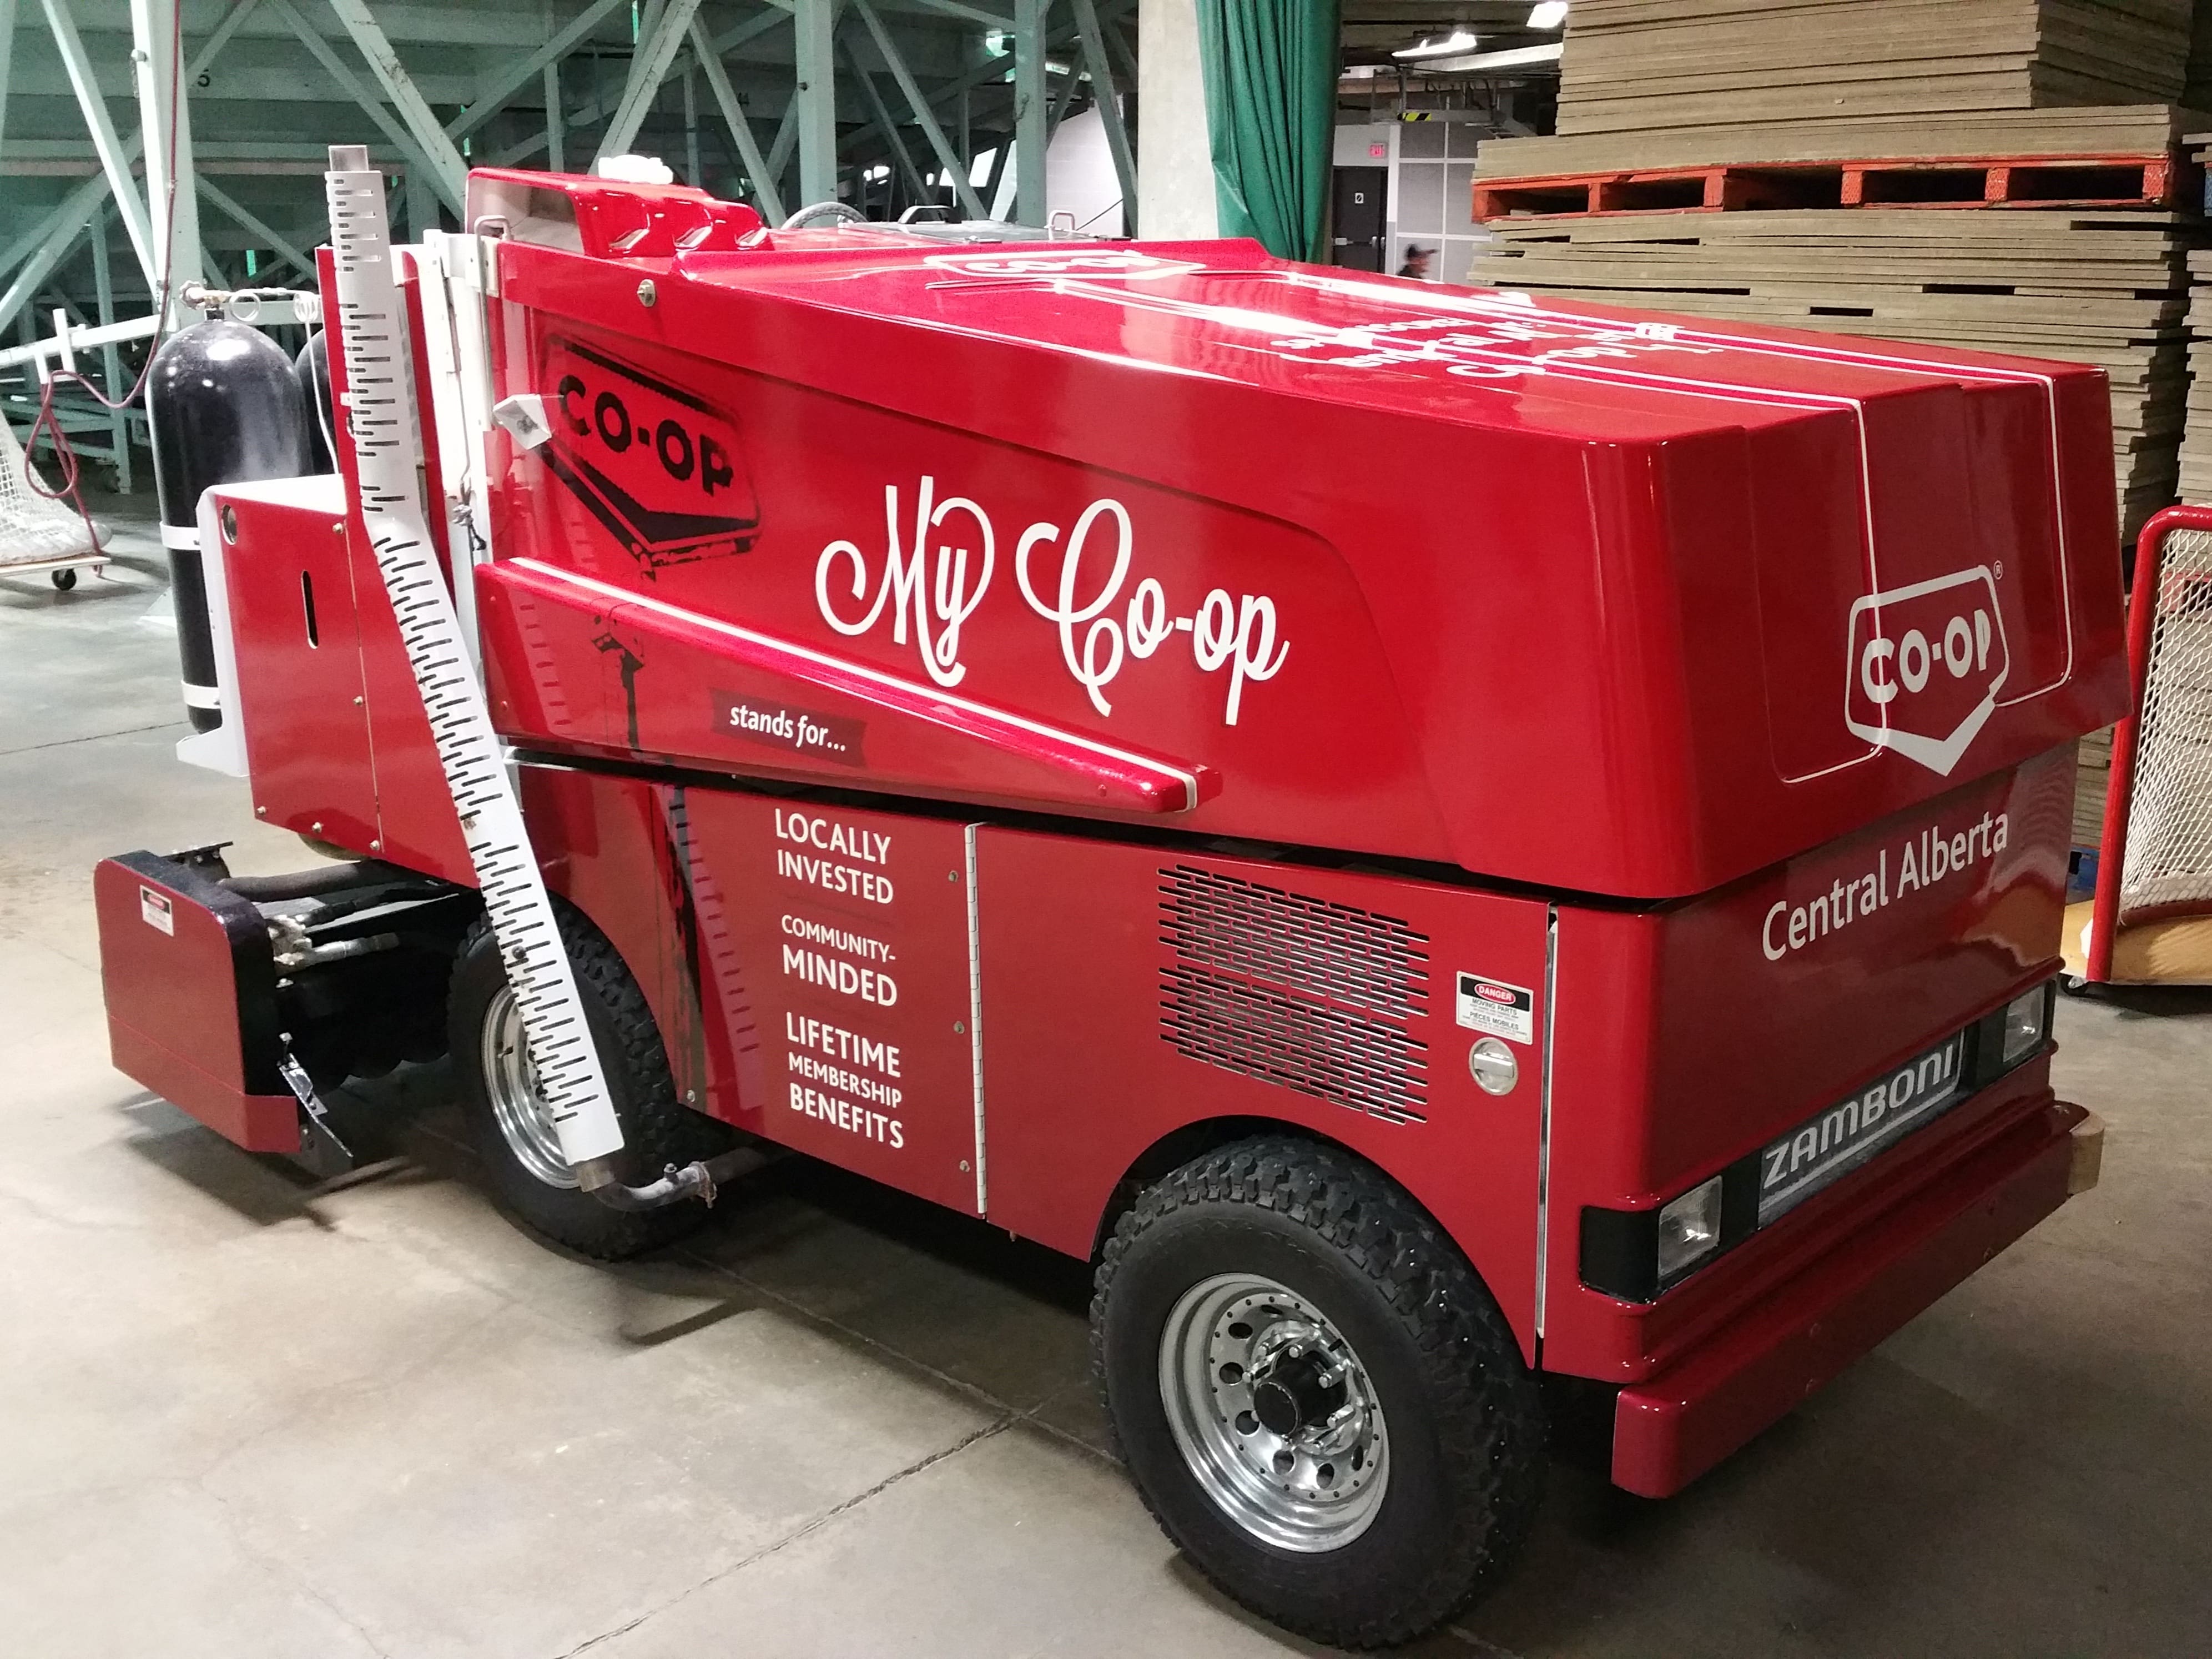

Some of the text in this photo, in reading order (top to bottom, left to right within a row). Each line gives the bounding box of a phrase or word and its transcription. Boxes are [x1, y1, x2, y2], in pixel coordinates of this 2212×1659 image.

[558, 374, 734, 497] CO-OP
[815, 475, 1291, 726] My Co-op
[1862, 609, 1991, 703] CO-OP
[729, 705, 794, 738] stands
[775, 808, 891, 865] LOCALLY
[777, 849, 894, 904] INVESTED
[1762, 811, 2009, 961] Central Alberta
[782, 914, 896, 963] COMMUNITY-
[783, 944, 898, 1007] MINDED
[1478, 985, 1512, 1001] DANGER
[1472, 998, 1496, 1009] MOVING
[1497, 1005, 1518, 1015] PARTS
[1492, 1017, 1519, 1030] MOBILES
[786, 1012, 901, 1078] LIFETIME
[788, 1052, 902, 1108] MEMBERSHIP
[790, 1082, 904, 1149] BENEFITS
